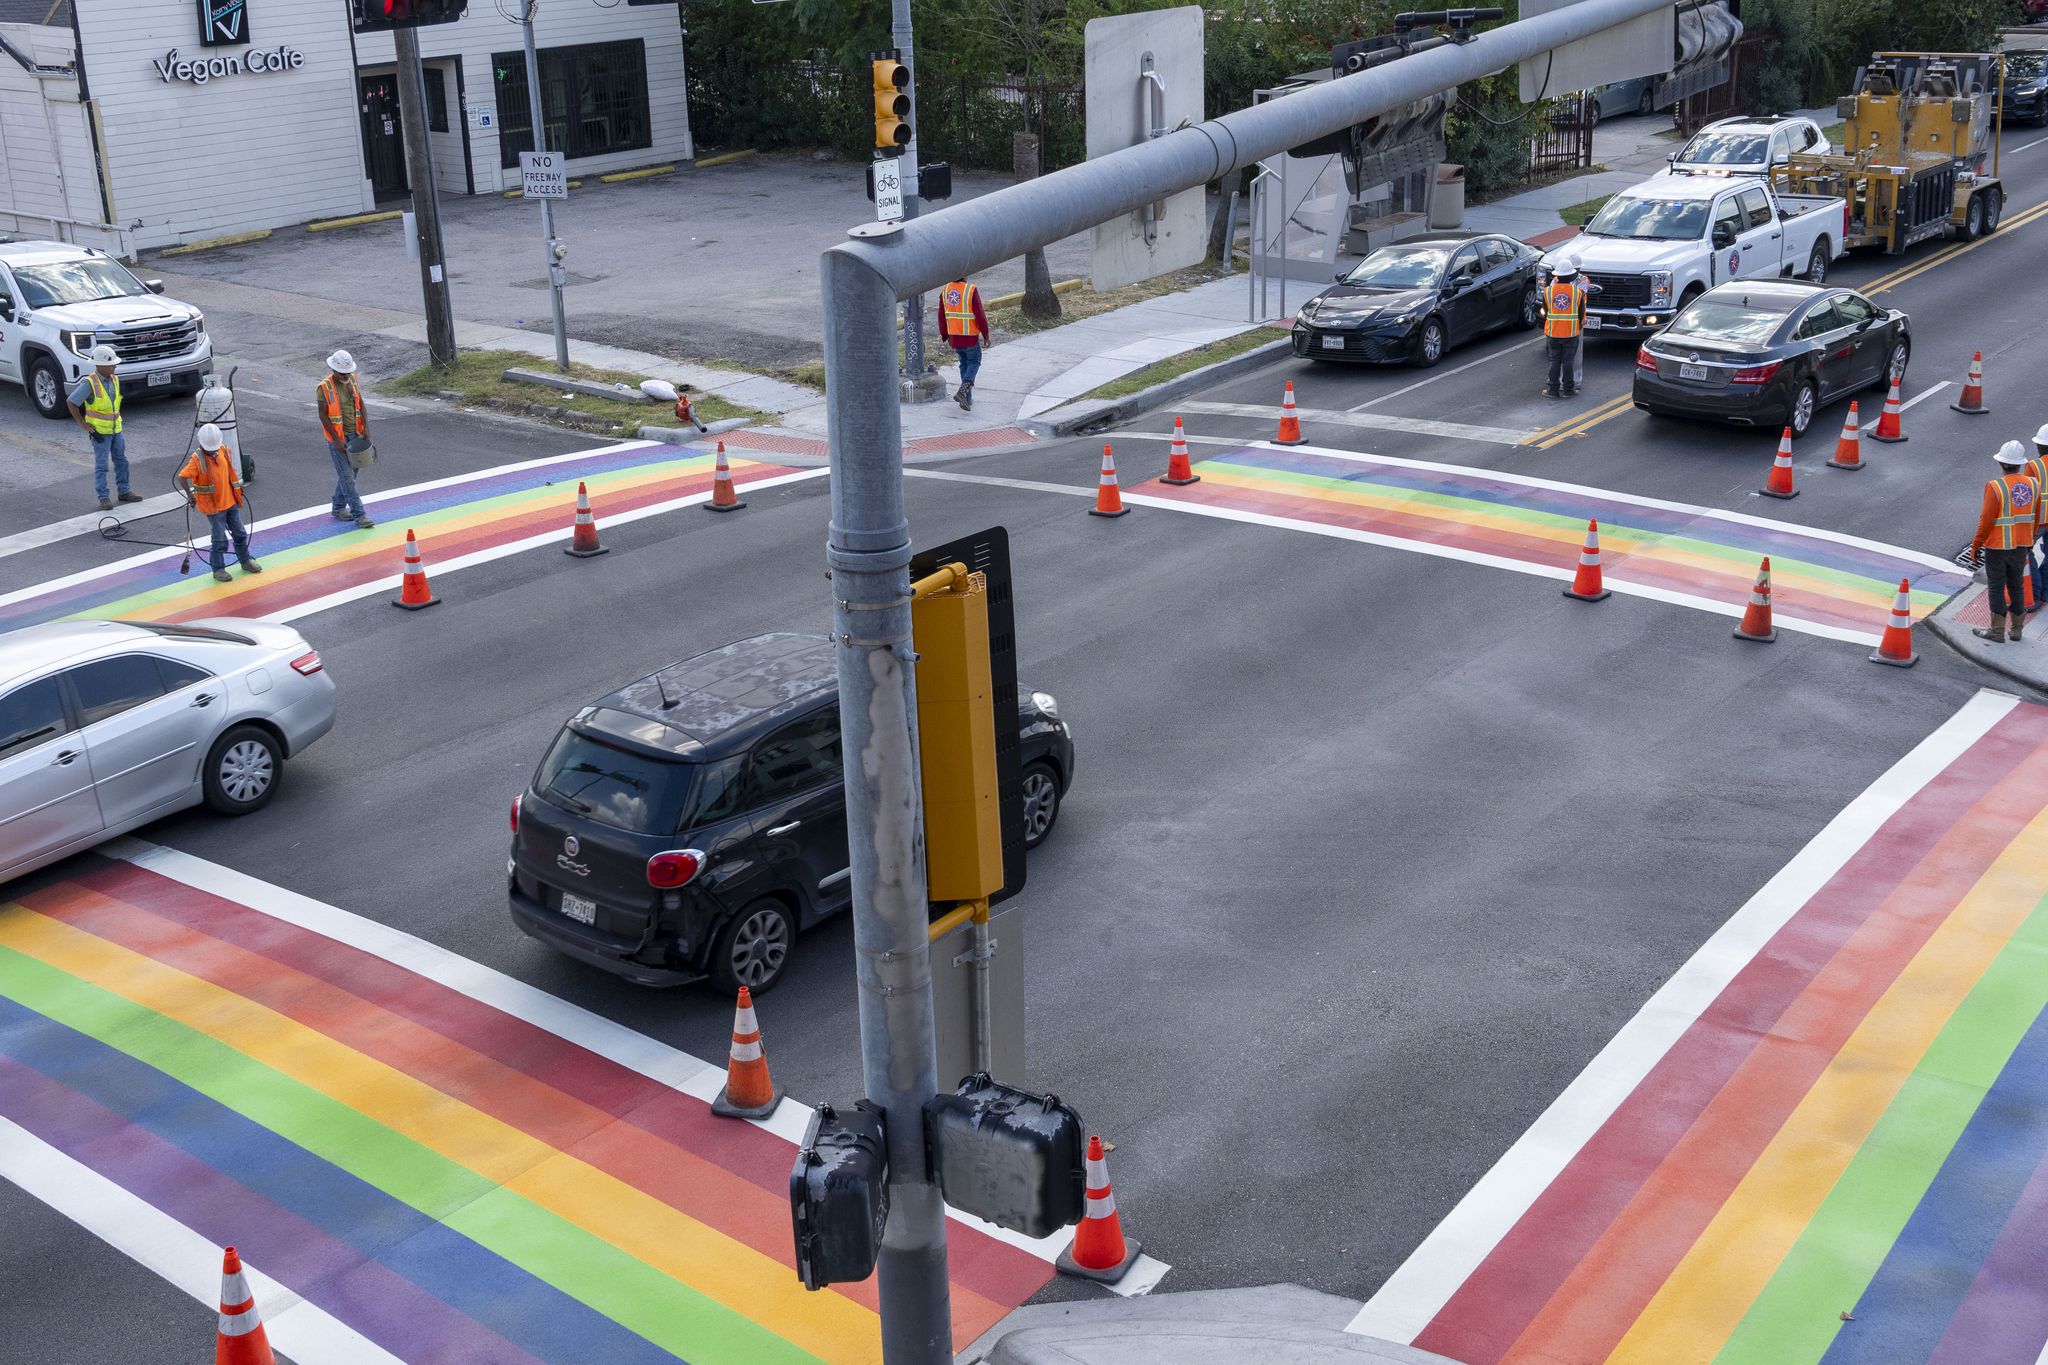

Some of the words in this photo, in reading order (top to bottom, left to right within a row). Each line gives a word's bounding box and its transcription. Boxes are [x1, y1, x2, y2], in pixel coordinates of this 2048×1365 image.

[153, 48, 241, 85] Vegan
[244, 45, 305, 74] Cafe
[532, 156, 552, 168] NO
[525, 172, 562, 182] FREEWAY
[526, 185, 563, 194] ACCESS
[878, 196, 901, 209] SIGNAL
[134, 331, 171, 343] GMC
